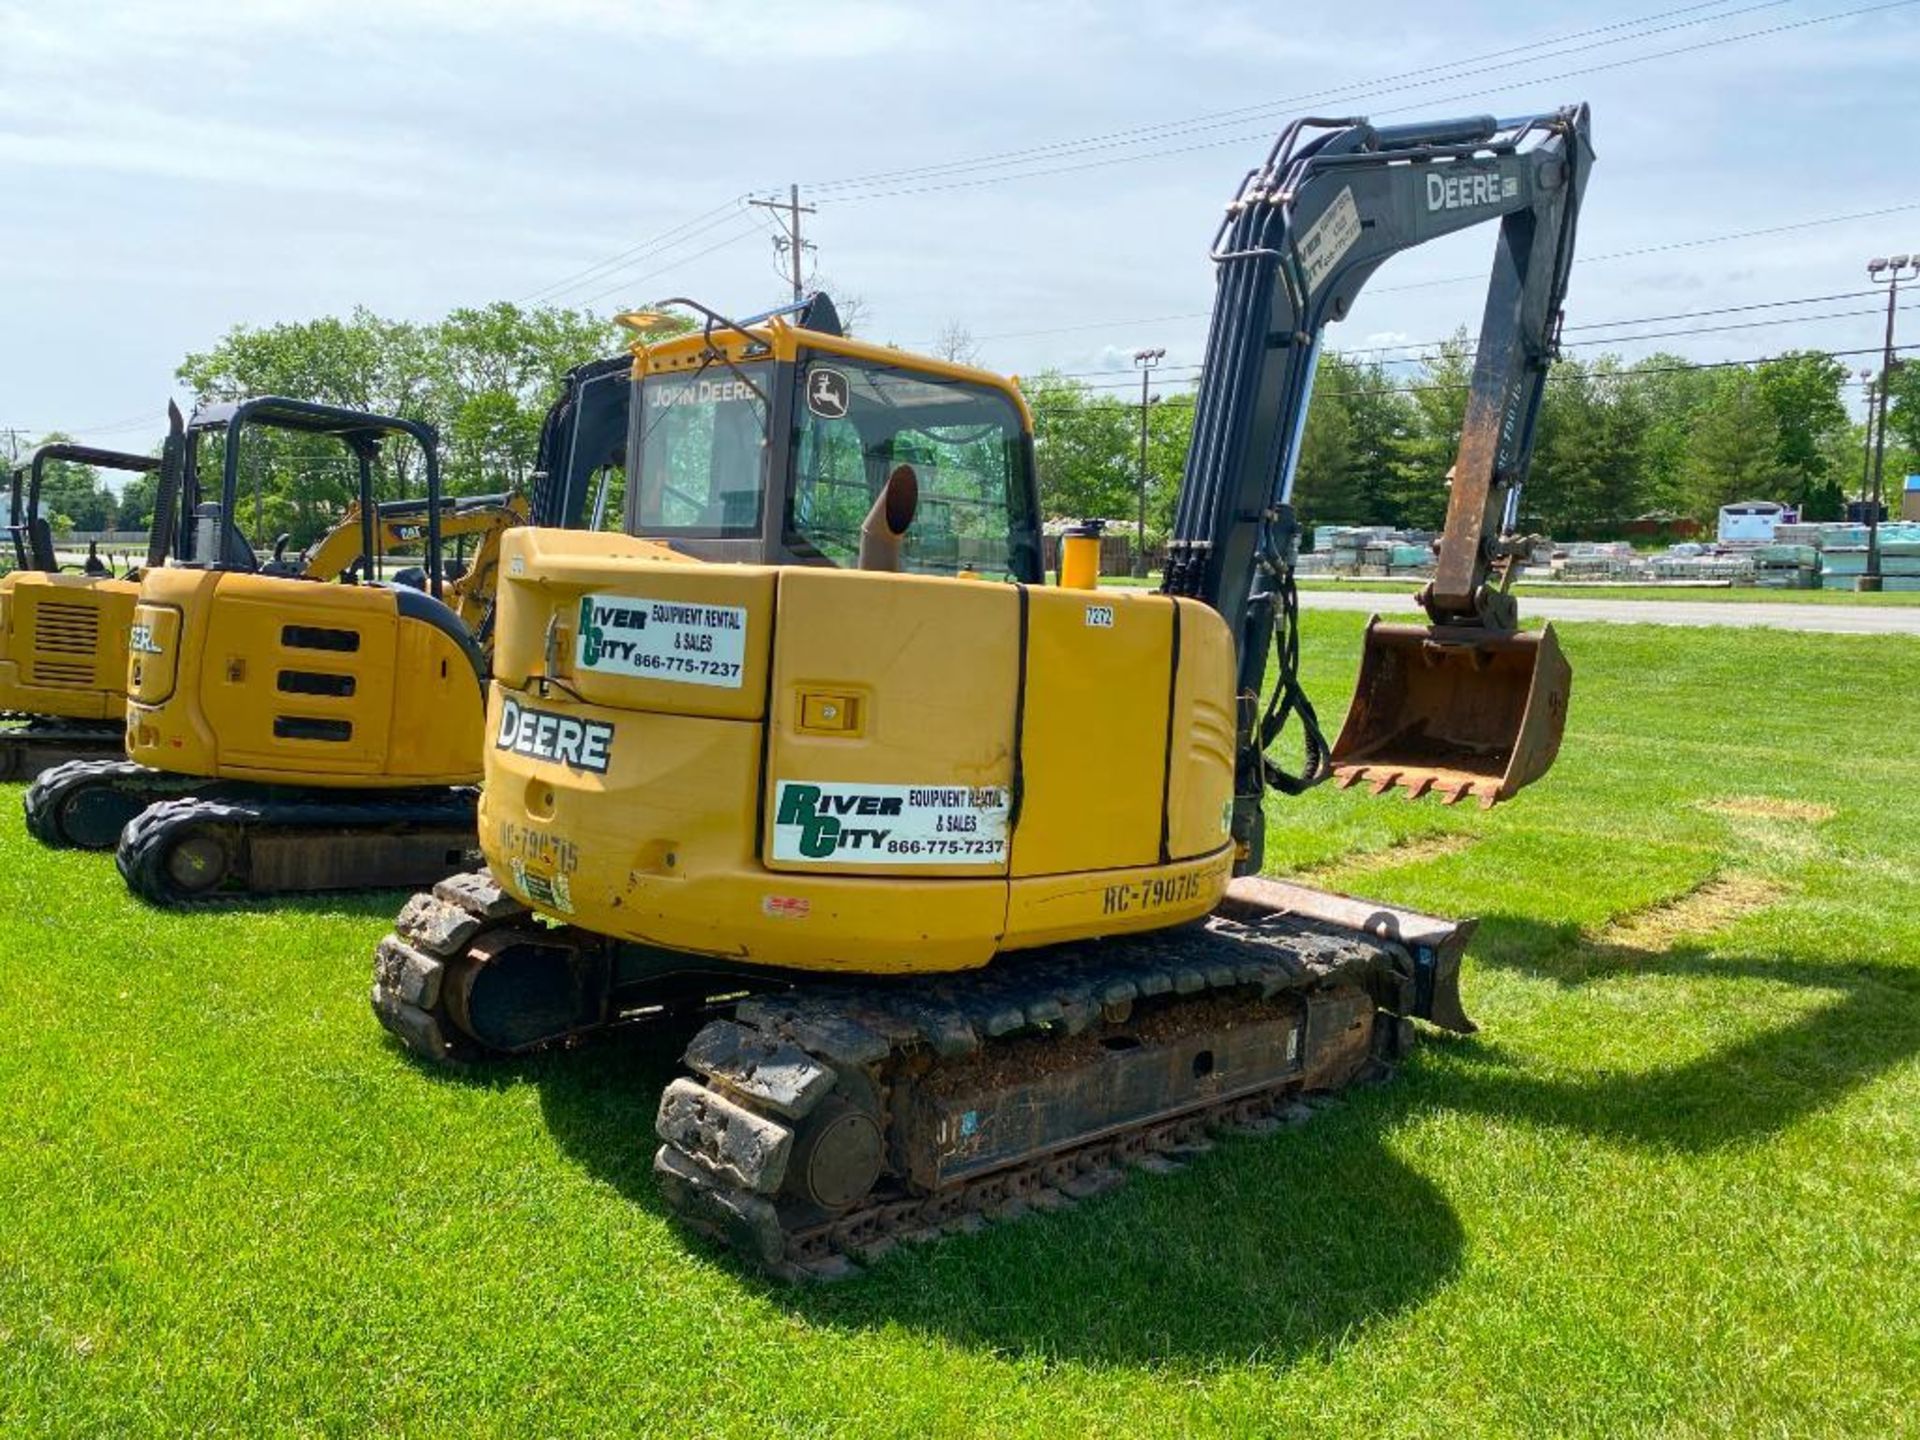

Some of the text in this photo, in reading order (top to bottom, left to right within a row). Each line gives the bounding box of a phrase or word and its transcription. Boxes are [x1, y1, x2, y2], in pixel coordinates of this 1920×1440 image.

[1427, 174, 1501, 211] DEERE
[652, 380, 758, 408] JOHN DEERE
[579, 597, 647, 635] RIVER
[652, 604, 741, 630] EQUIPMENT RENTAL
[583, 627, 638, 667] CITY
[674, 632, 713, 653] & SALES
[634, 653, 741, 677] 866-775-7237
[498, 700, 612, 769] DEERE
[777, 784, 903, 825] RIVER
[909, 789, 1004, 808] EQUIPMENT RENTAL
[799, 816, 892, 858] CITY
[936, 815, 977, 832] & SALES
[887, 840, 1004, 855] 866-775-7237
[1103, 873, 1199, 915] RC-790715
